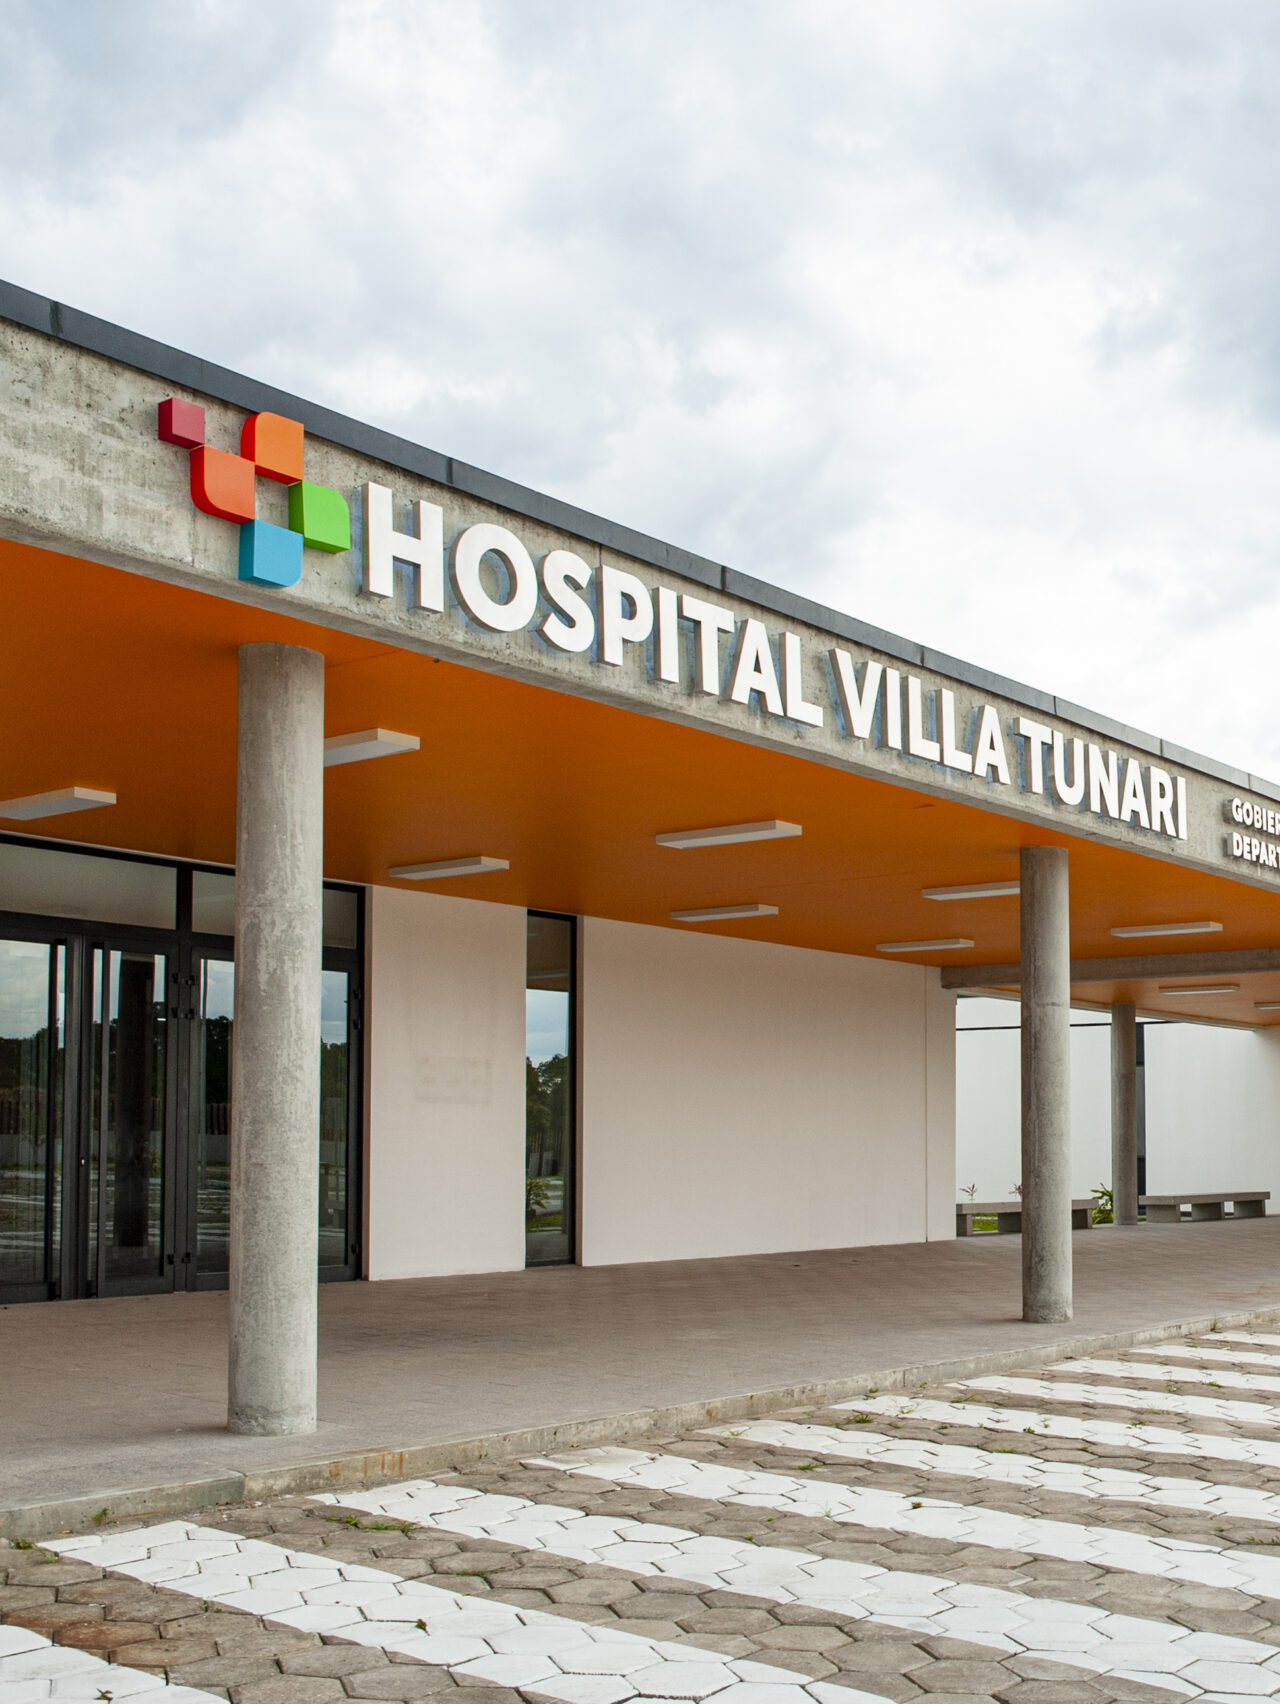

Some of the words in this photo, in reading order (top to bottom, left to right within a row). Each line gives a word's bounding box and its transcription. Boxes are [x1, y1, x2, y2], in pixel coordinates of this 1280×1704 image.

[363, 481, 824, 728] HOSPITAL
[831, 647, 1011, 785] VILLA
[1014, 716, 1188, 840] TUNARI
